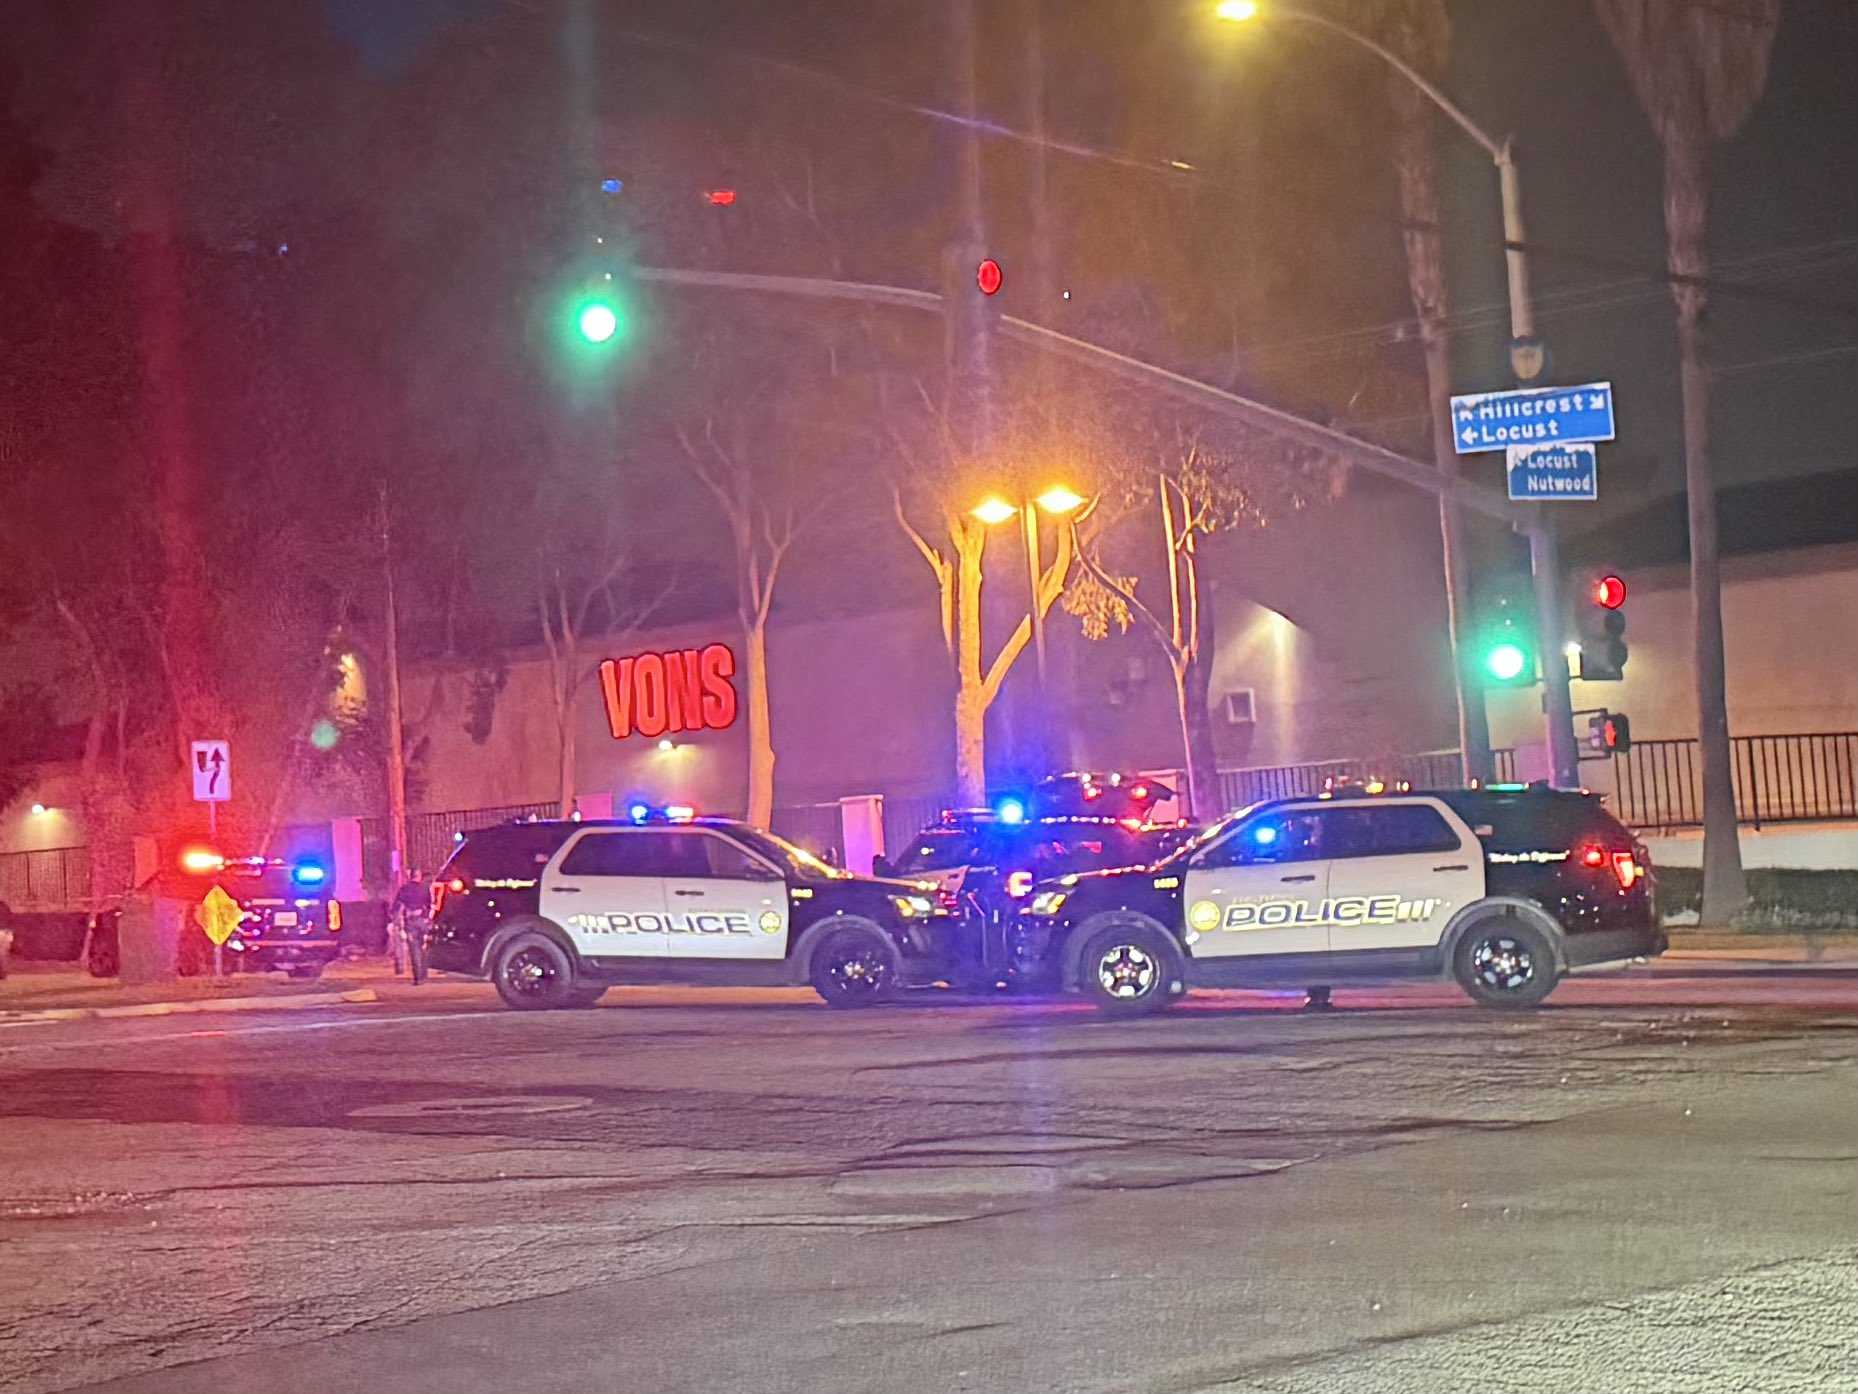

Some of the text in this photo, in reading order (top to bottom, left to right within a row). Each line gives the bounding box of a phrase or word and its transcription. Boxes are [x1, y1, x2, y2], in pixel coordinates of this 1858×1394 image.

[1480, 394, 1583, 420] Hillcrest
[1482, 420, 1559, 442] Locust
[1527, 452, 1578, 469] Locust
[1527, 474, 1592, 493] Nutwood
[600, 643, 737, 738] VONS
[605, 912, 752, 934] POLICE
[1225, 896, 1399, 930] POLICE
